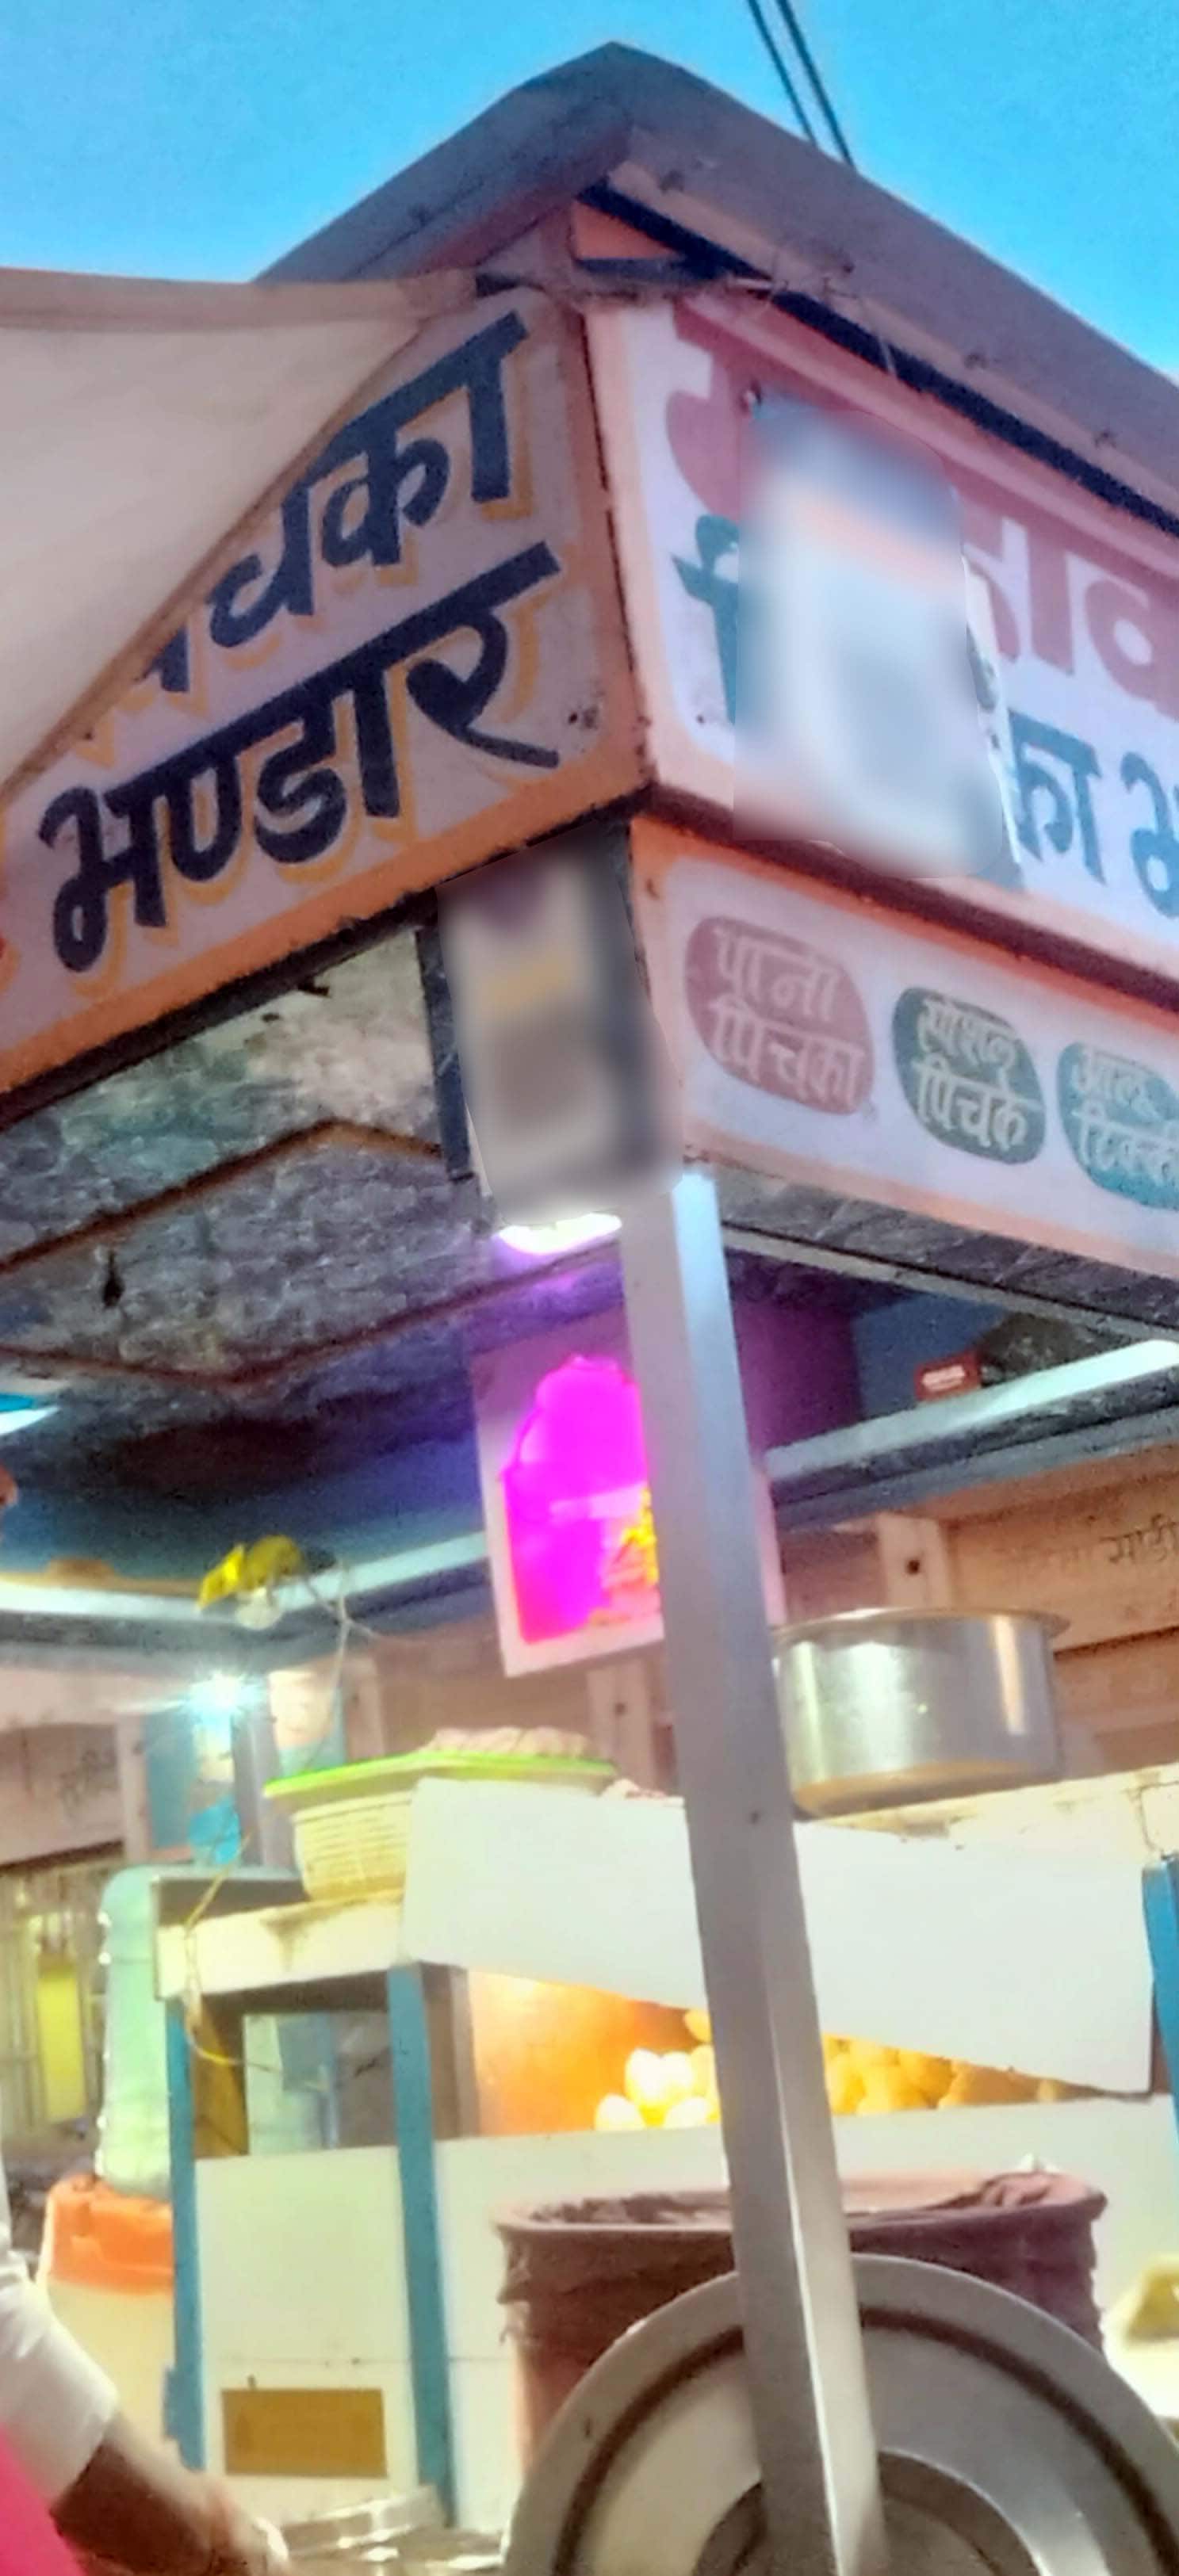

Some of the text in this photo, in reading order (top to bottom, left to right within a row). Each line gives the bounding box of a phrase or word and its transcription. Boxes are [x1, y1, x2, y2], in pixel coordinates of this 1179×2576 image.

[145, 310, 530, 692] चका
[38, 541, 561, 972] भण्डार
[708, 993, 866, 1108] पिचका
[711, 926, 845, 1022] पानी
